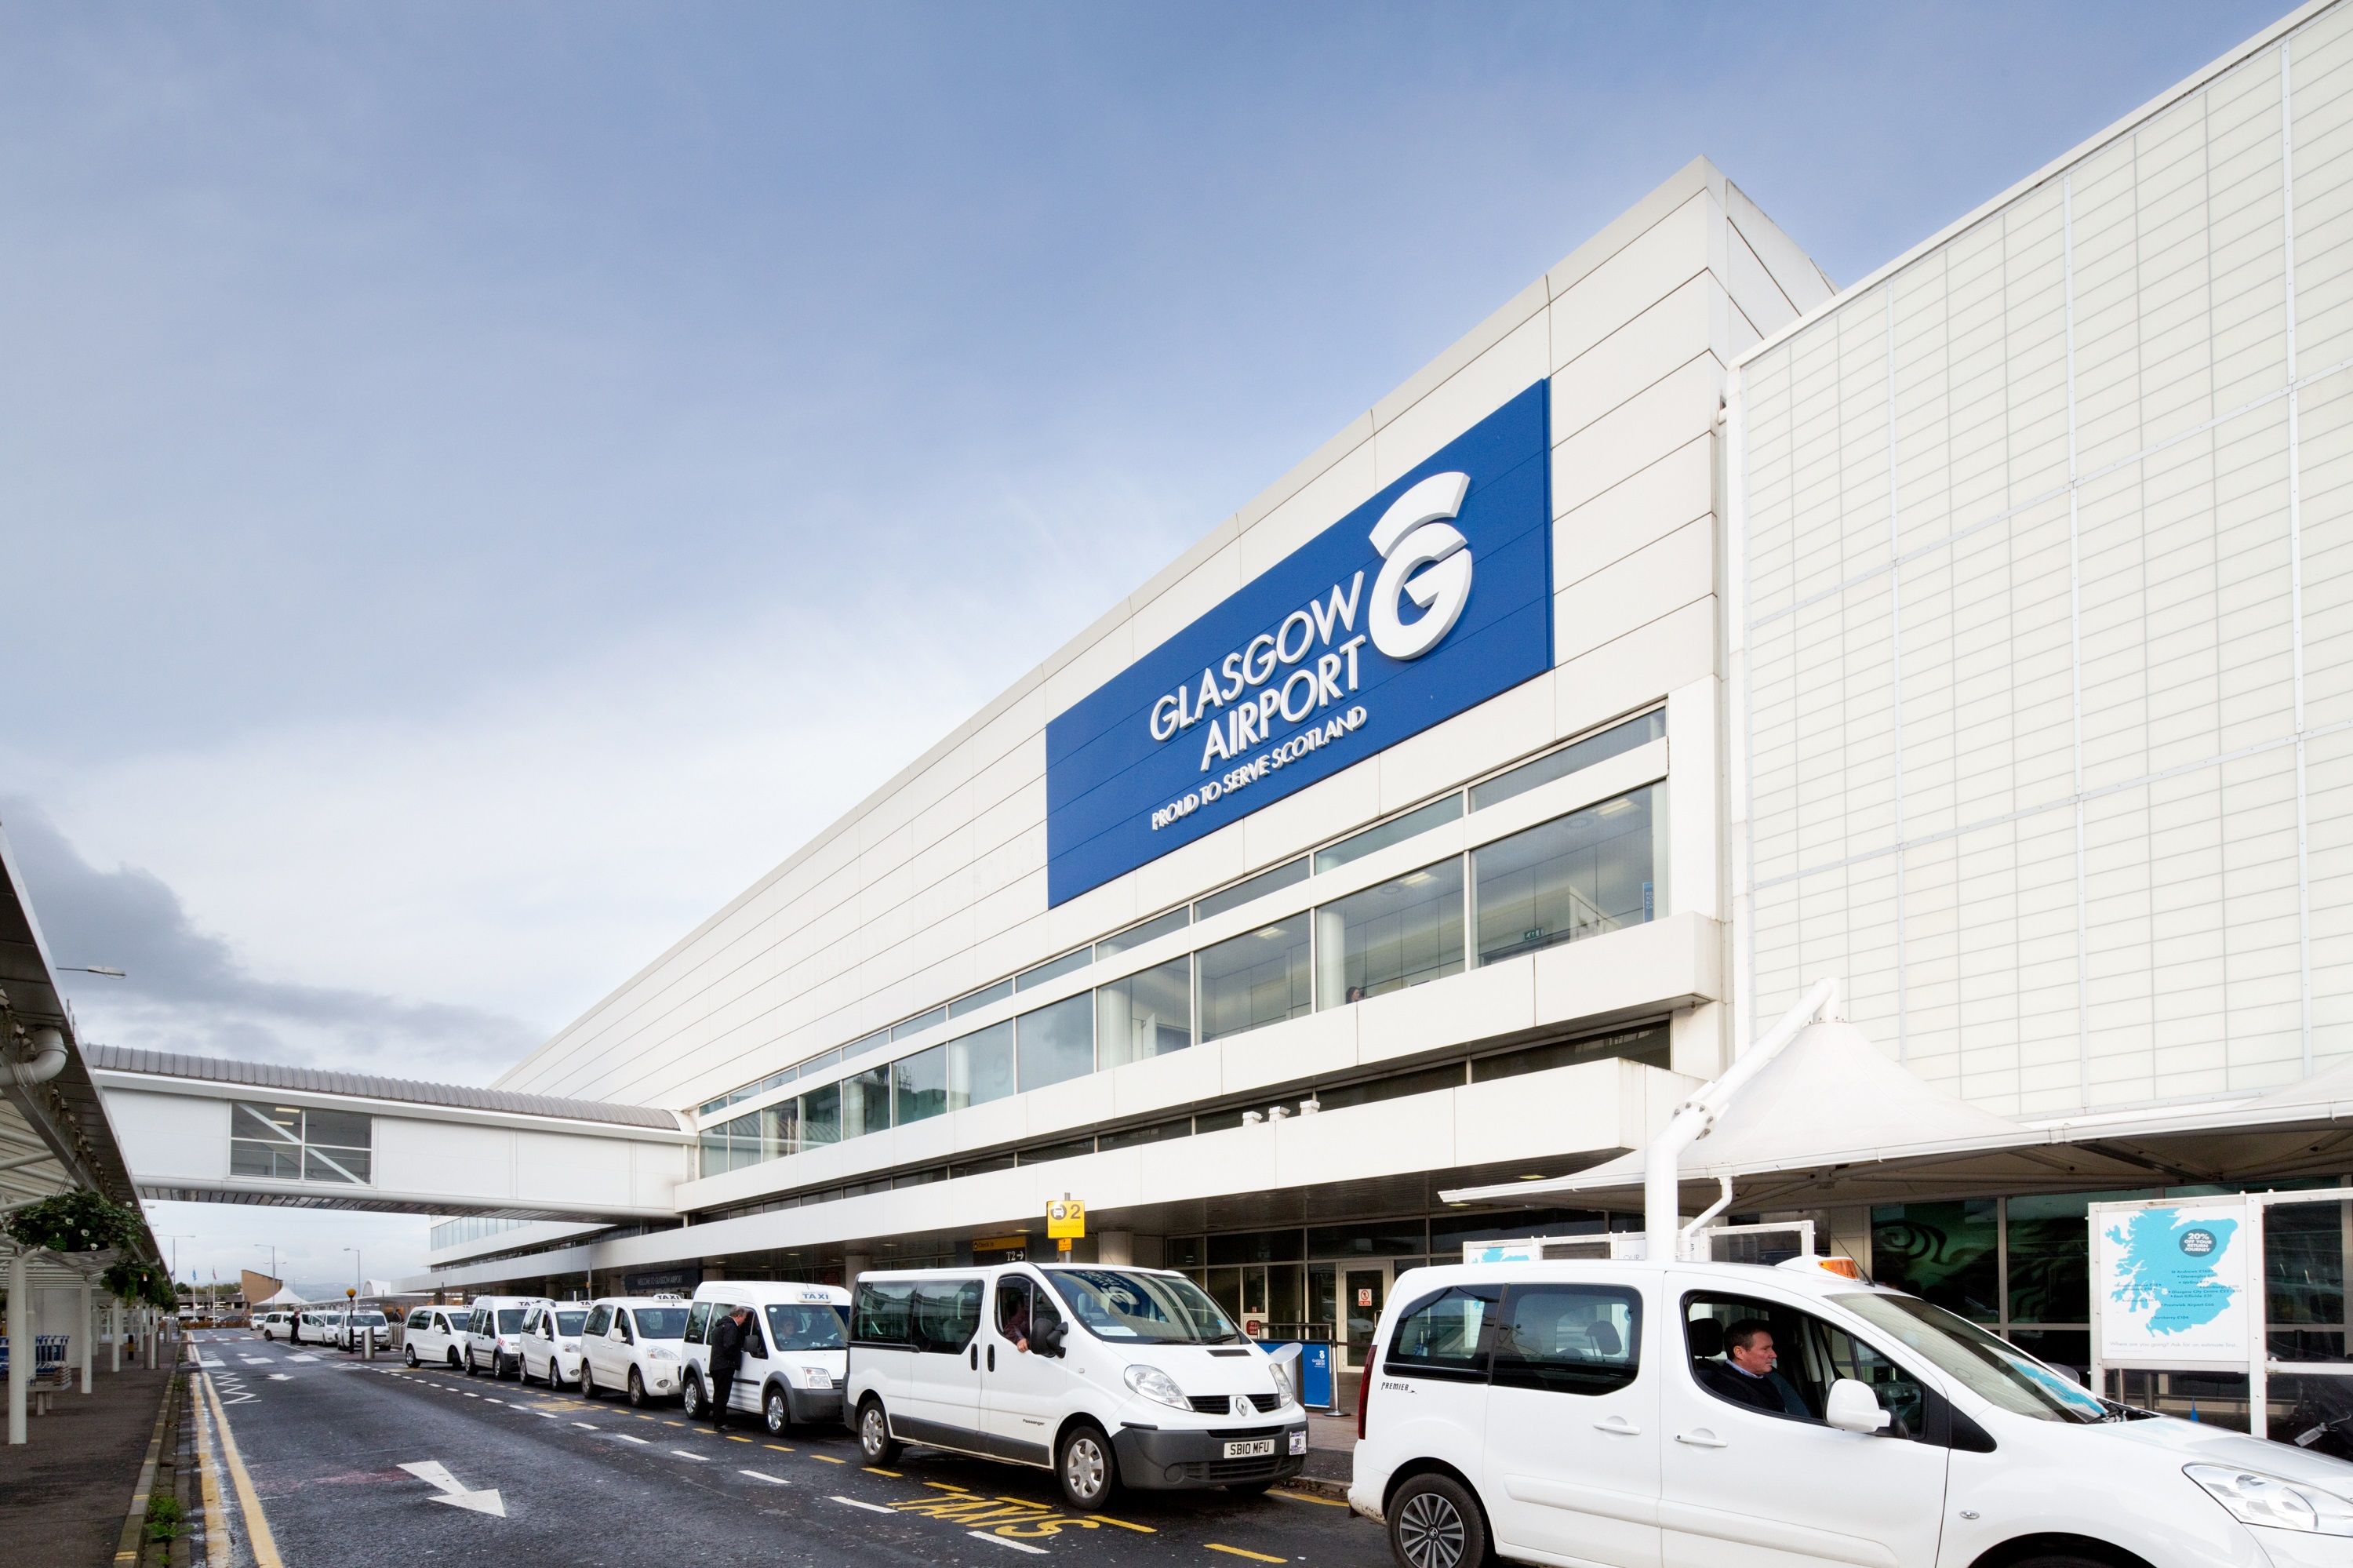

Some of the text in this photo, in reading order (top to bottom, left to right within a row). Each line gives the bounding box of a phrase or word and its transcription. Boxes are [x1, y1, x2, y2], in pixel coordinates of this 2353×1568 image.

[1151, 570, 1364, 741] GLASGOW
[1200, 635, 1366, 772] AIRPORT
[1152, 706, 1366, 831] PROUD TO SERVE SCOTLAND
[1070, 1204, 1081, 1219] 2
[1006, 1251, 1016, 1261] T2
[1381, 1382, 1409, 1391] PREMIER
[1230, 1442, 1269, 1455] SB10 MFU
[886, 1493, 1100, 1537] TAXIS
